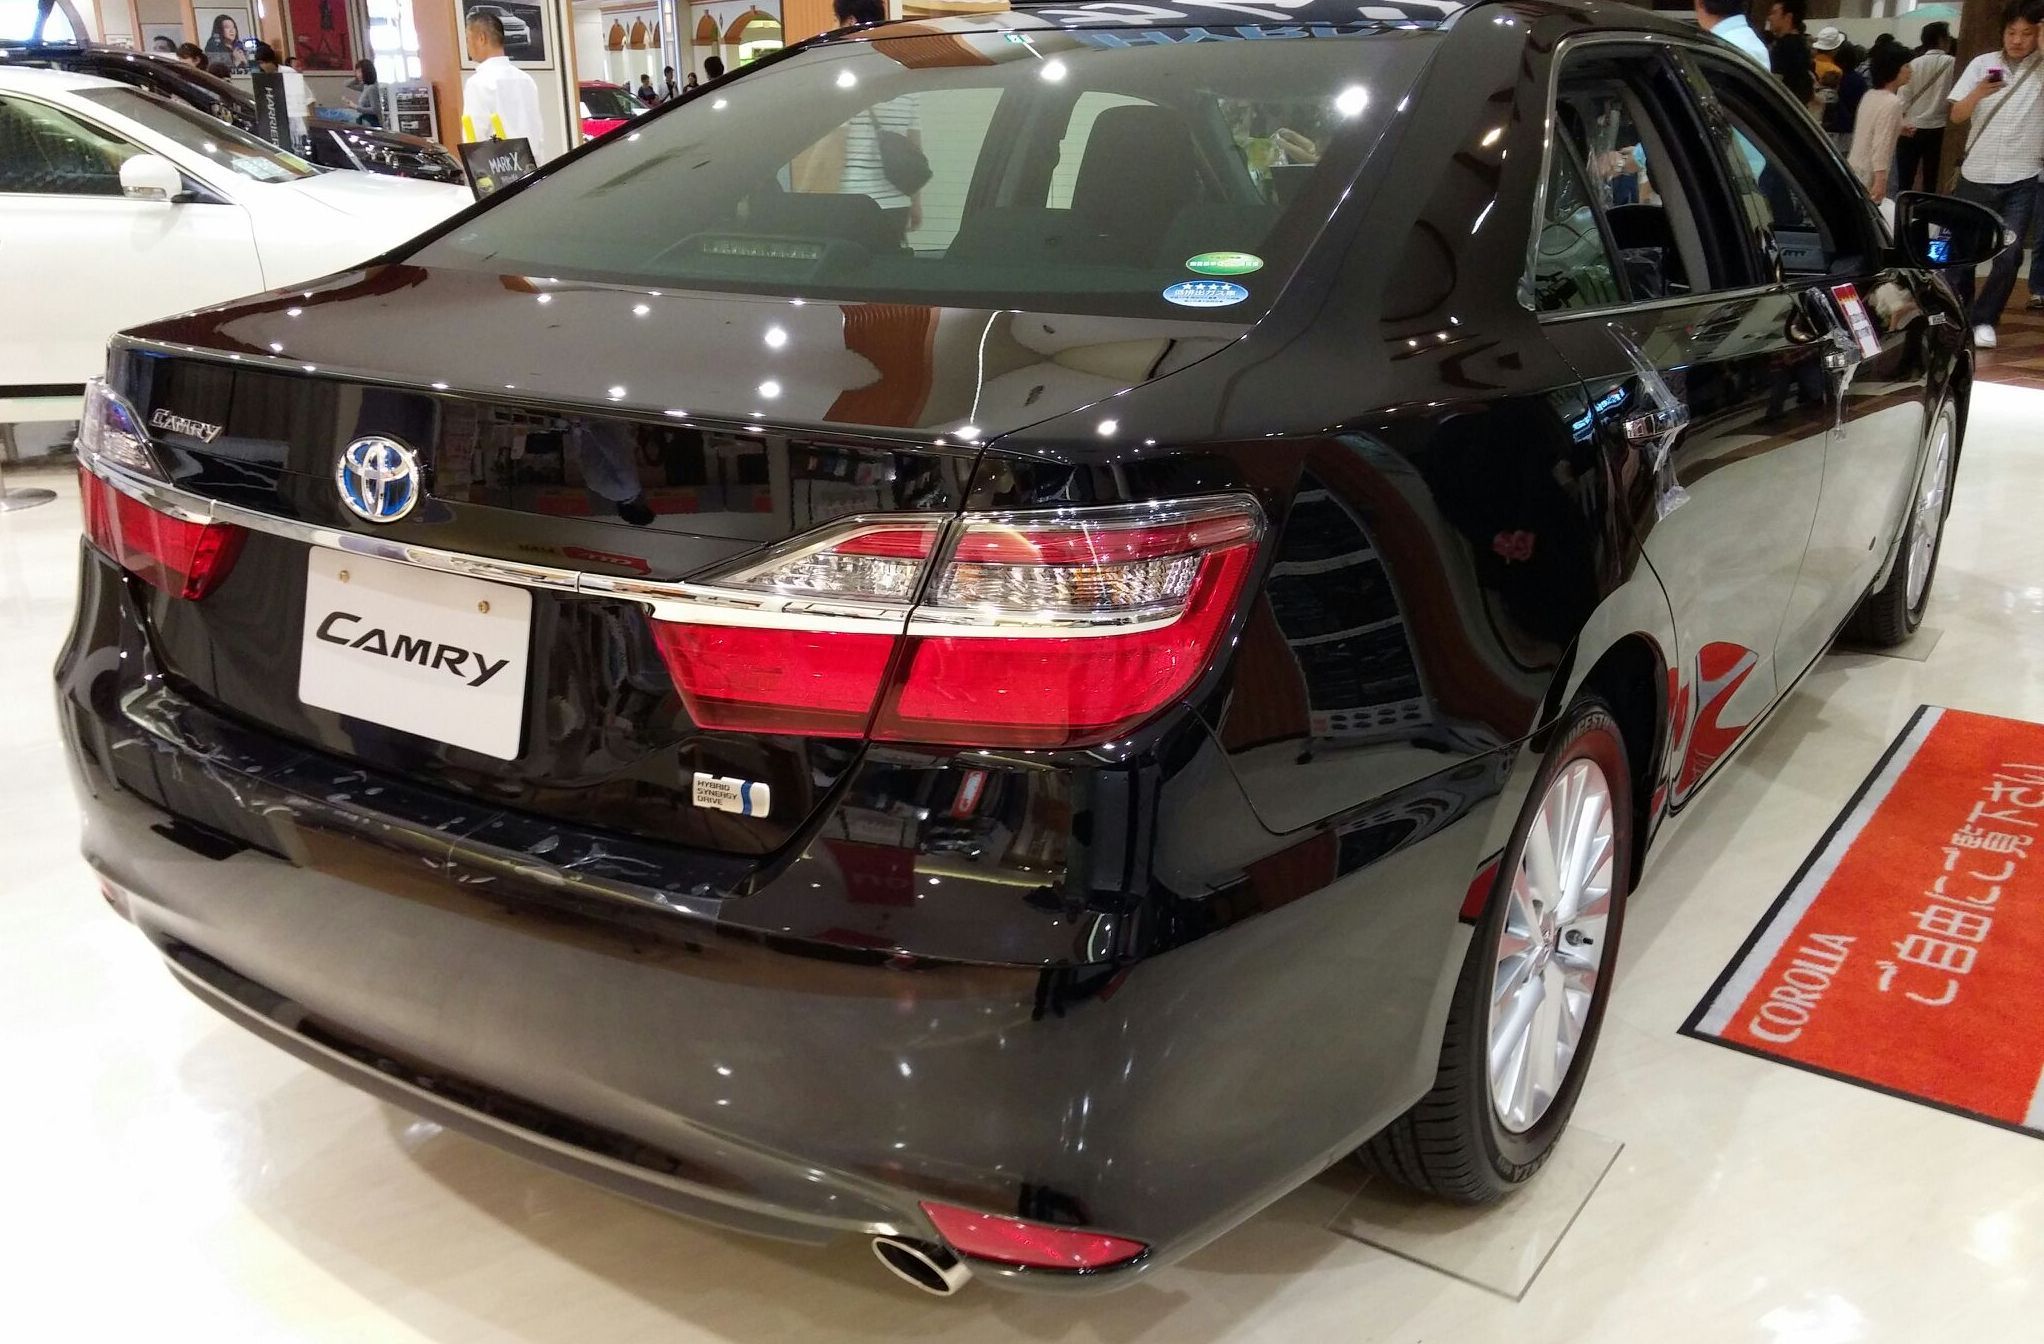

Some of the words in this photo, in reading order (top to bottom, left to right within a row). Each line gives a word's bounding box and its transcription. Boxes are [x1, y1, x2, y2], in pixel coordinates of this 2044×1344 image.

[488, 155, 513, 174] MARK
[149, 408, 222, 443] CAMRY
[316, 611, 511, 687] CAMRY
[697, 780, 731, 792] HYBRID
[697, 787, 738, 801] SYNERGY
[697, 795, 723, 806] DRIVE
[1748, 932, 1858, 1043] COROLLA
